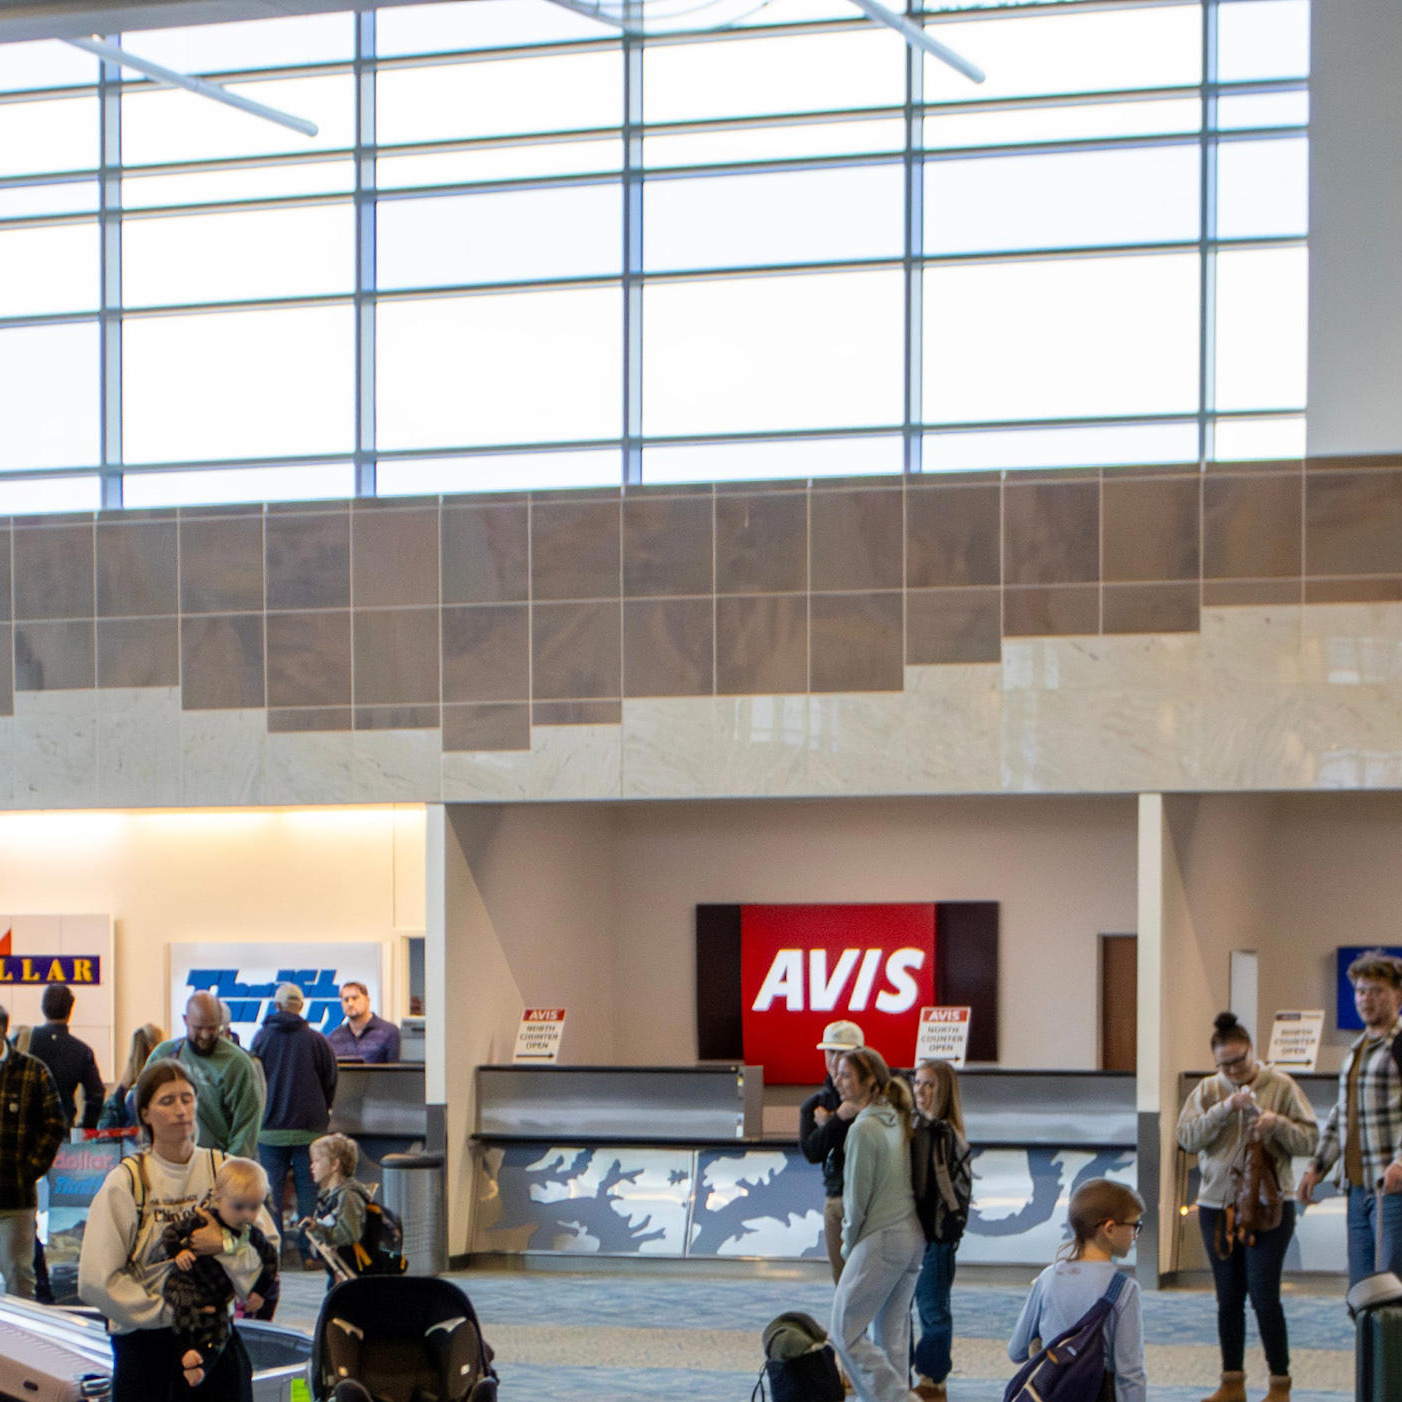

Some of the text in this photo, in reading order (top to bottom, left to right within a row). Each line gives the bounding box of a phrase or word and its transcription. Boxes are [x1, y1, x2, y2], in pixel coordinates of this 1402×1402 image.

[751, 948, 925, 1014] AVIS
[528, 1010, 558, 1020] AVIS
[928, 1010, 960, 1020] AVIS
